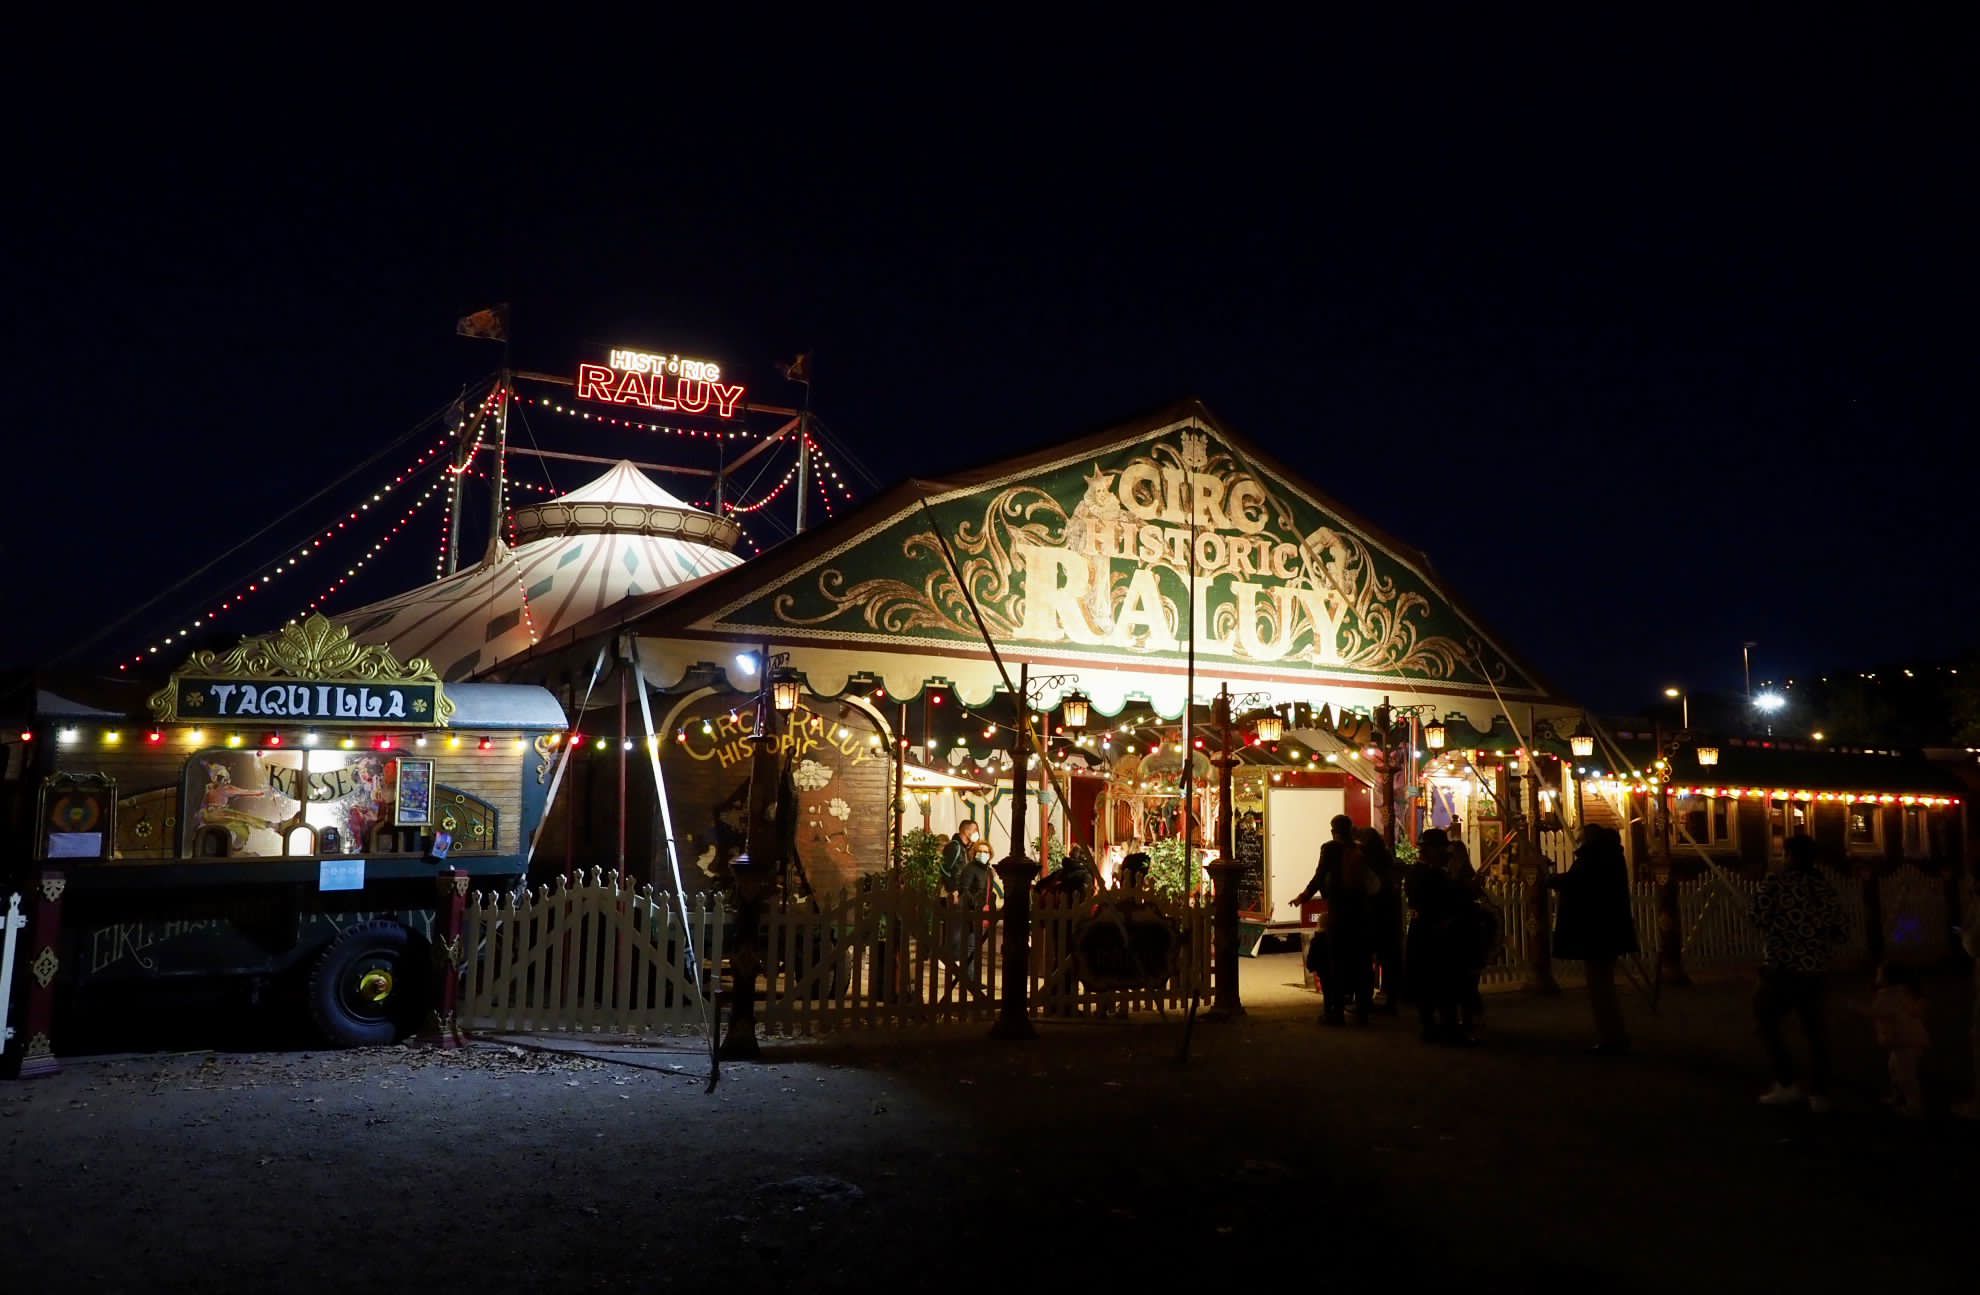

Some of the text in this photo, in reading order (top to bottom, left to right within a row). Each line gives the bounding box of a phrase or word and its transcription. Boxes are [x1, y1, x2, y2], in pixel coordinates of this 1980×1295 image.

[577, 363, 745, 417] RALUY
[1118, 463, 1269, 534] CIRC
[1086, 516, 1300, 579] HISTORIC
[1012, 544, 1352, 667] RALUY
[210, 684, 407, 718] TAQUILLA
[716, 733, 819, 769] HISORIC
[788, 703, 872, 767] RALUY
[269, 764, 354, 801] KASSE
